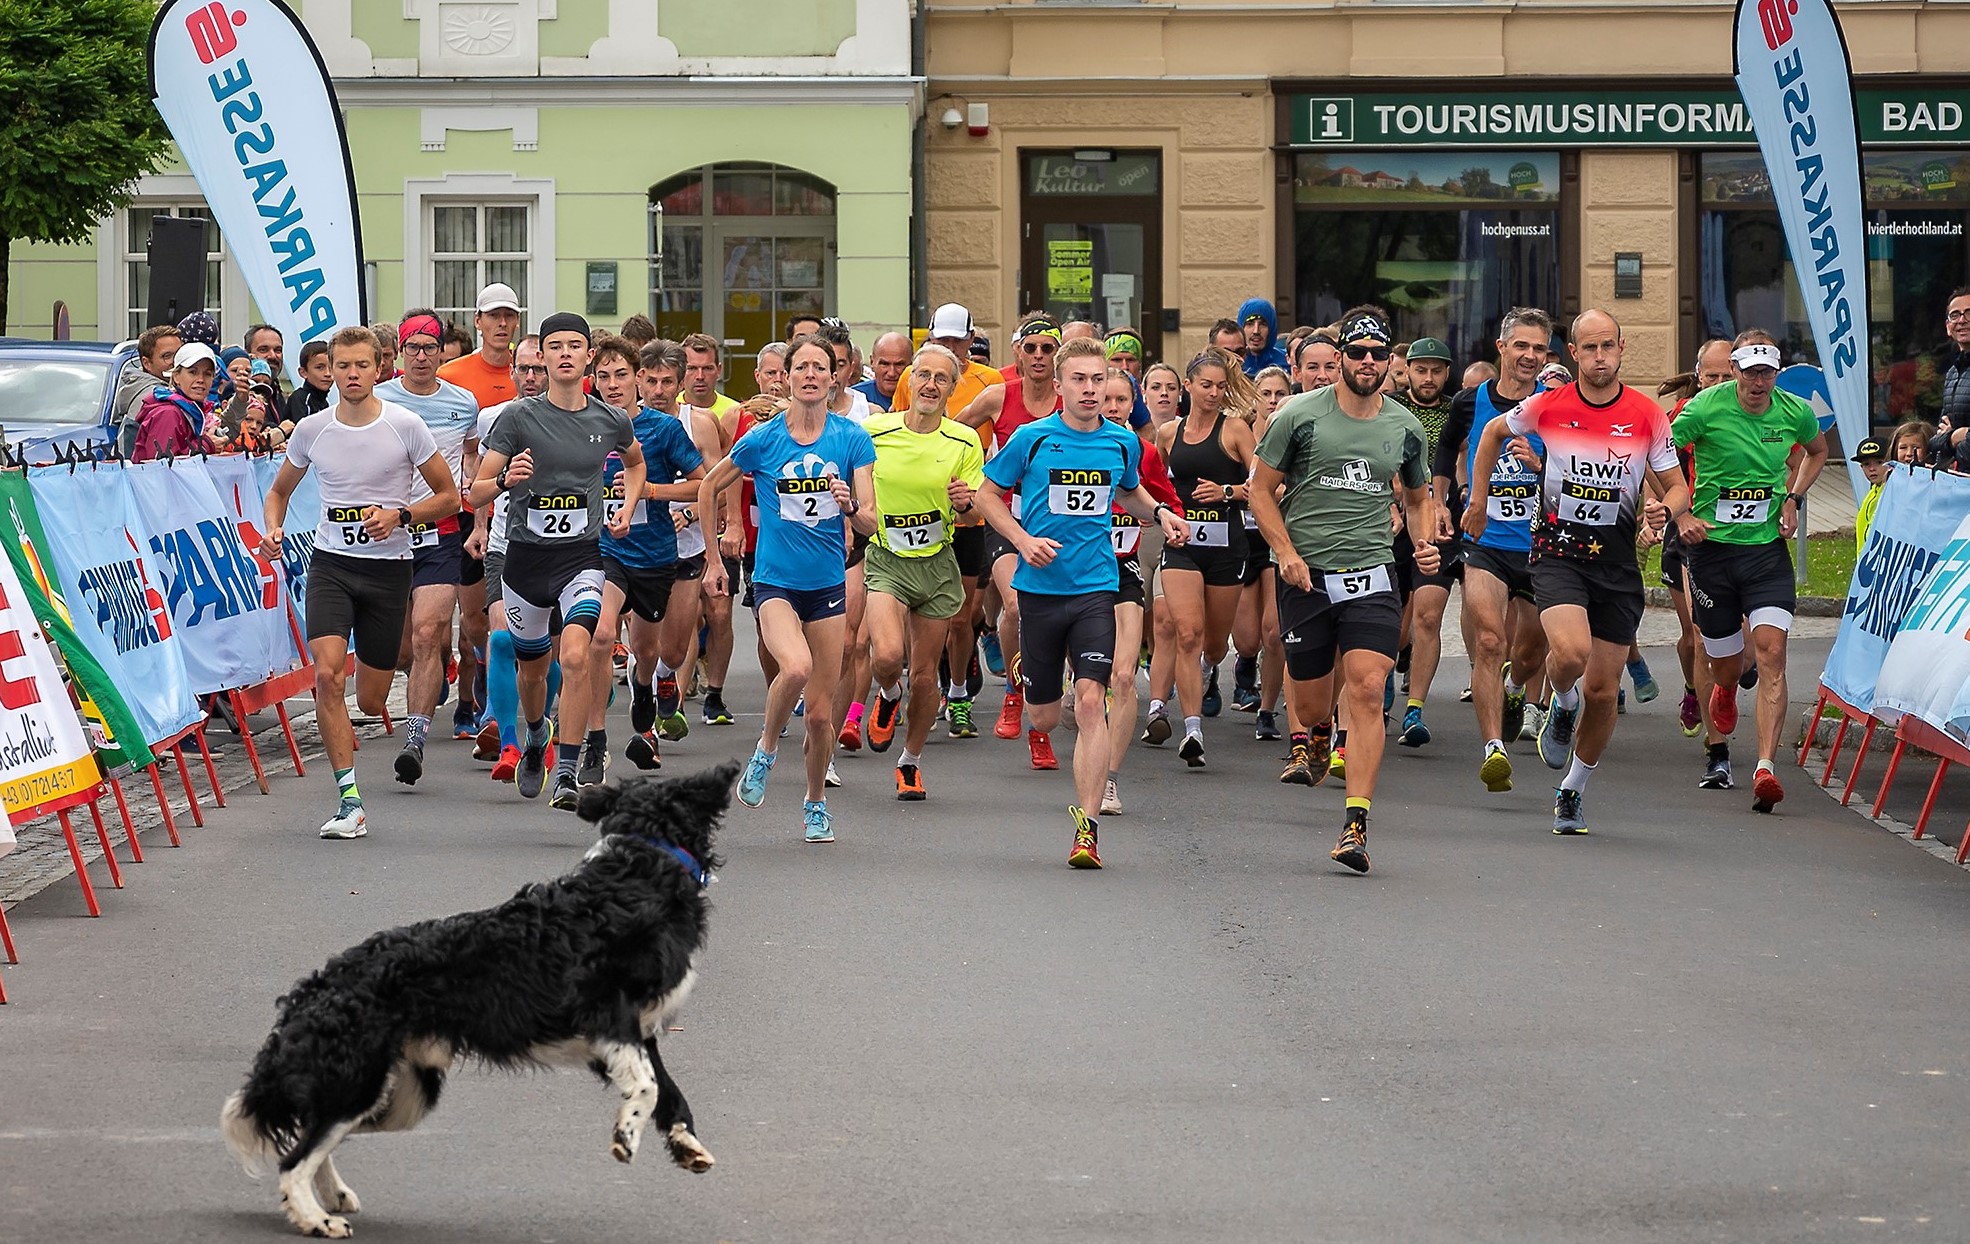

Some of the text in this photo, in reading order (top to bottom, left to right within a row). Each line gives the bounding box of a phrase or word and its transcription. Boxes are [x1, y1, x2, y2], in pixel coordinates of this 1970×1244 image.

[1882, 101, 1964, 132] BAD
[1039, 159, 1087, 178] Leo
[1118, 165, 1149, 187] open
[1510, 170, 1532, 179] HOCH
[1922, 169, 1944, 178] HOCH
[1035, 178, 1105, 193] Kultur
[1481, 222, 1551, 239] hochgenuss.at
[1050, 258, 1091, 267] Open Air
[1571, 455, 1624, 480] lawi
[804, 497, 818, 517] 2
[1066, 489, 1096, 511] 52
[1500, 499, 1527, 518] 55
[1574, 502, 1602, 522] 64
[1730, 503, 1756, 520] 32
[543, 513, 572, 534] 26
[342, 525, 370, 546] 56
[903, 528, 930, 547] 12
[1196, 525, 1208, 542] 6
[1343, 574, 1371, 595] 57
